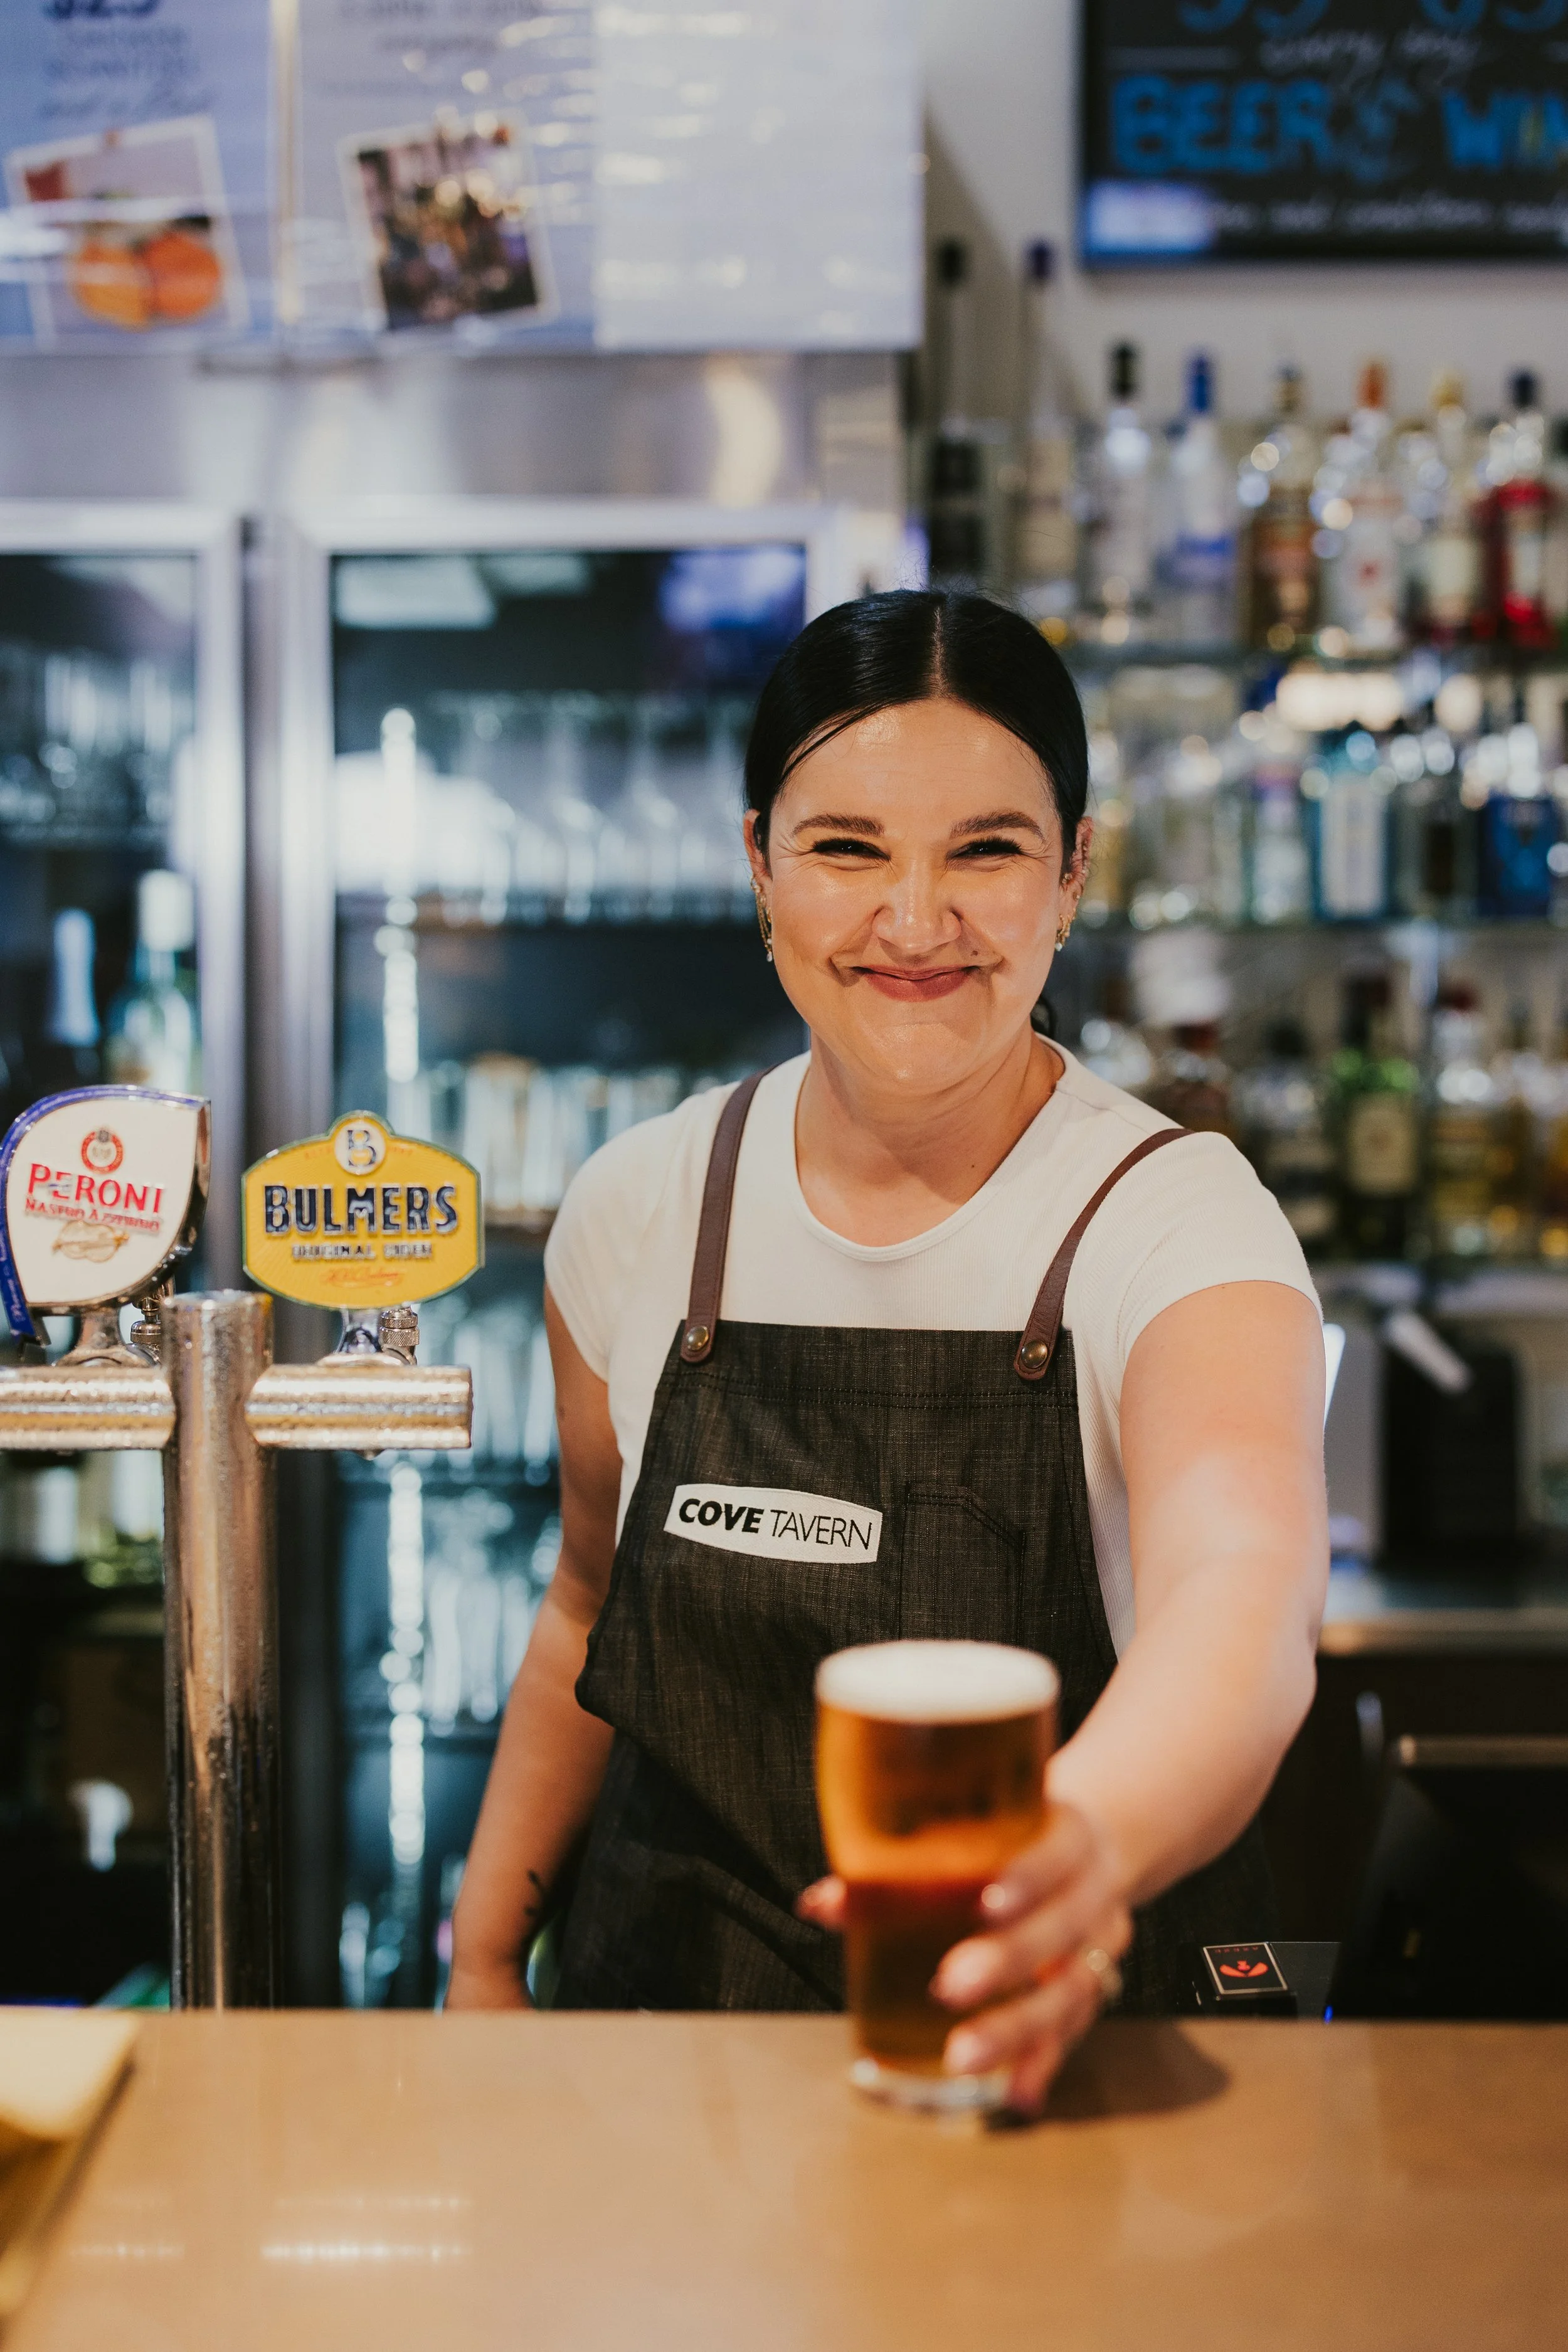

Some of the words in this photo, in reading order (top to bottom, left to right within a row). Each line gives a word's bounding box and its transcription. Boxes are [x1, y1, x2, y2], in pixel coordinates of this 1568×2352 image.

[28, 1162, 164, 1214] PERONI
[263, 1184, 459, 1234] BULMERS
[679, 1498, 765, 1534] COVE
[770, 1509, 872, 1550] TAVERN
